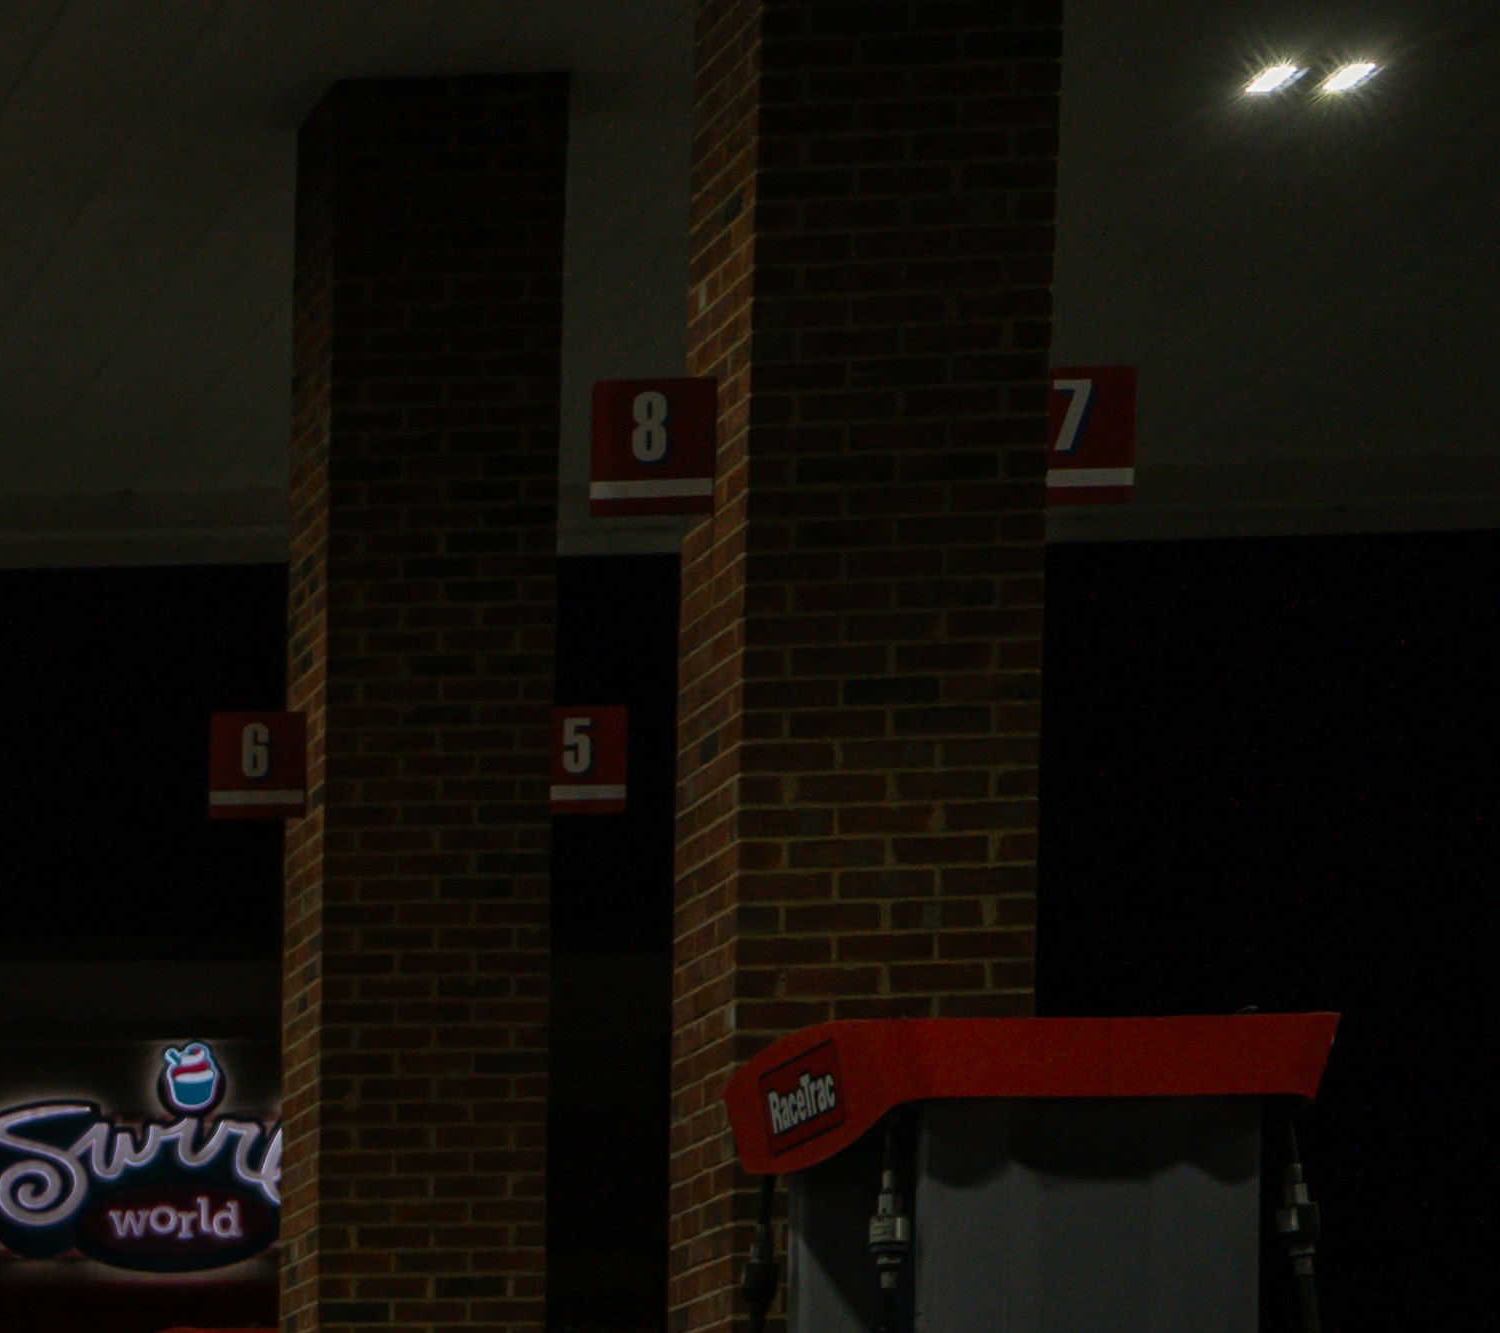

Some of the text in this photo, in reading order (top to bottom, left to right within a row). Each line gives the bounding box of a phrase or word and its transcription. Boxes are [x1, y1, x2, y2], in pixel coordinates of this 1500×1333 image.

[631, 389, 669, 462] 8
[1052, 378, 1092, 452] 7
[240, 721, 271, 779] 6
[562, 716, 592, 775] 5
[767, 1072, 837, 1135] RaceTrac
[108, 1196, 244, 1241] world
